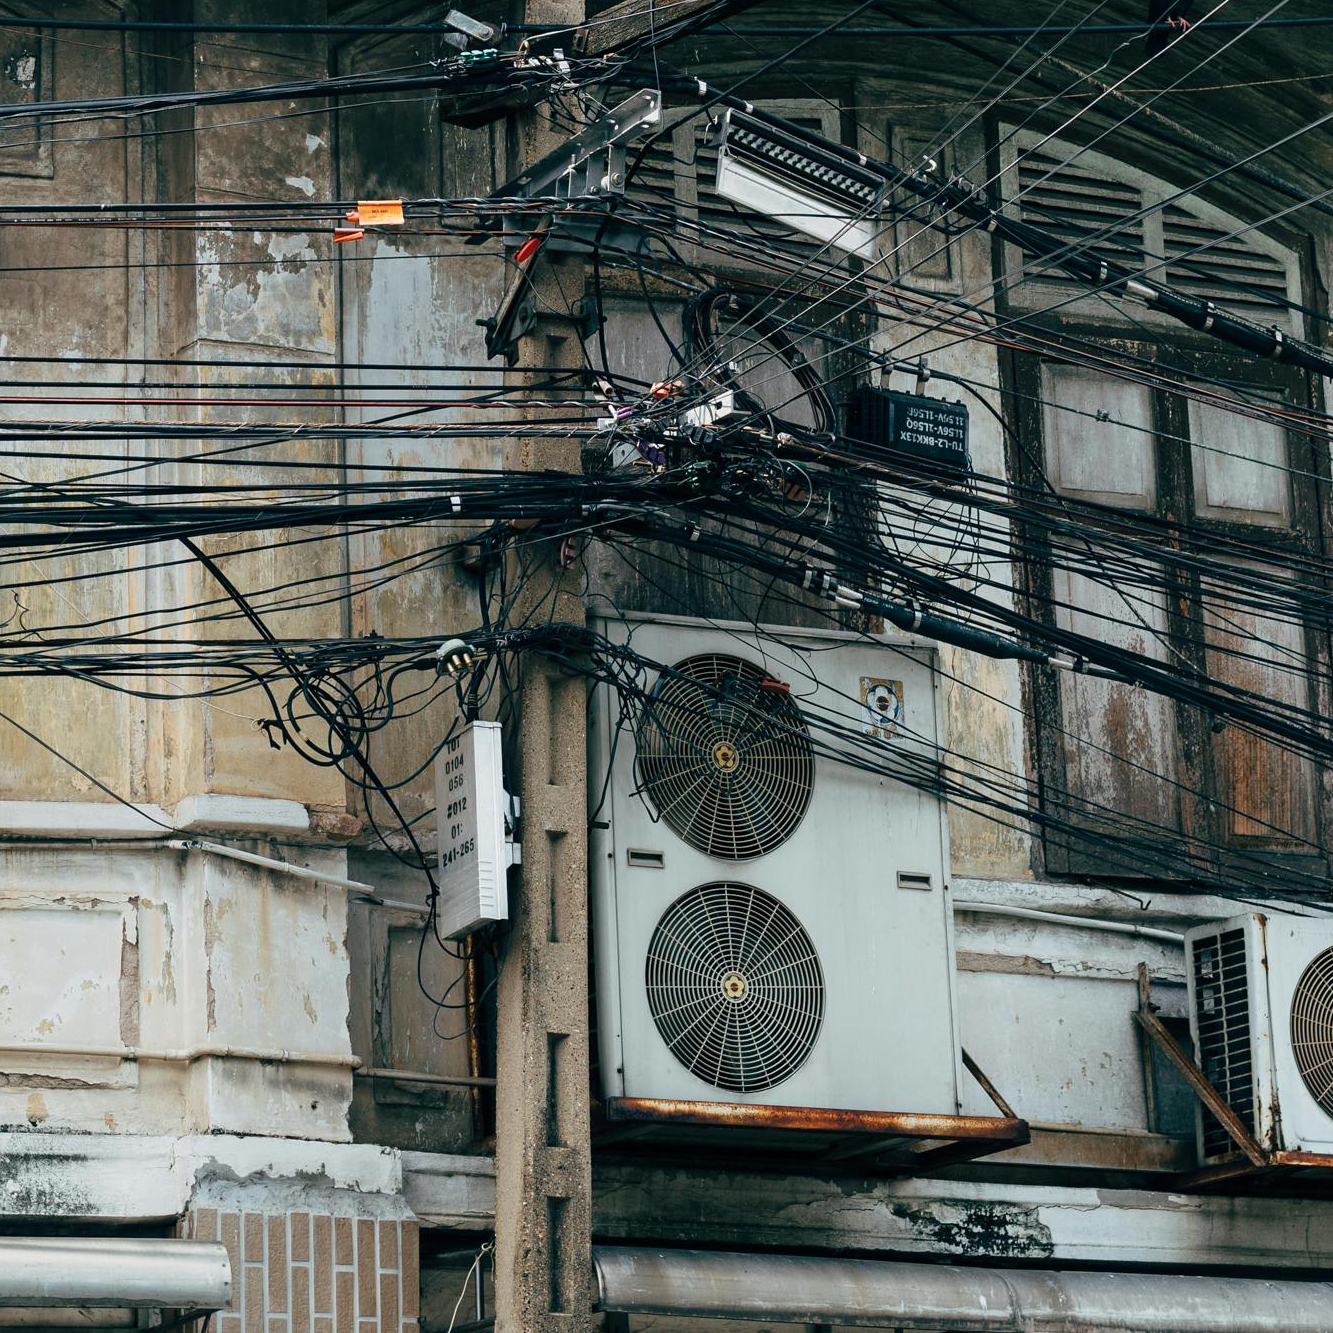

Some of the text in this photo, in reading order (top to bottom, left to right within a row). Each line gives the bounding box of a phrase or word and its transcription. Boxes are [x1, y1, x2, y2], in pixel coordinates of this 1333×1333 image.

[906, 418, 964, 438] 1L56V-1L56Q
[900, 430, 964, 452] TU-L2-BKK13X
[445, 753, 464, 775] 0104
[448, 773, 464, 792] 056
[447, 797, 467, 820] #012
[442, 838, 475, 868] 241-265
